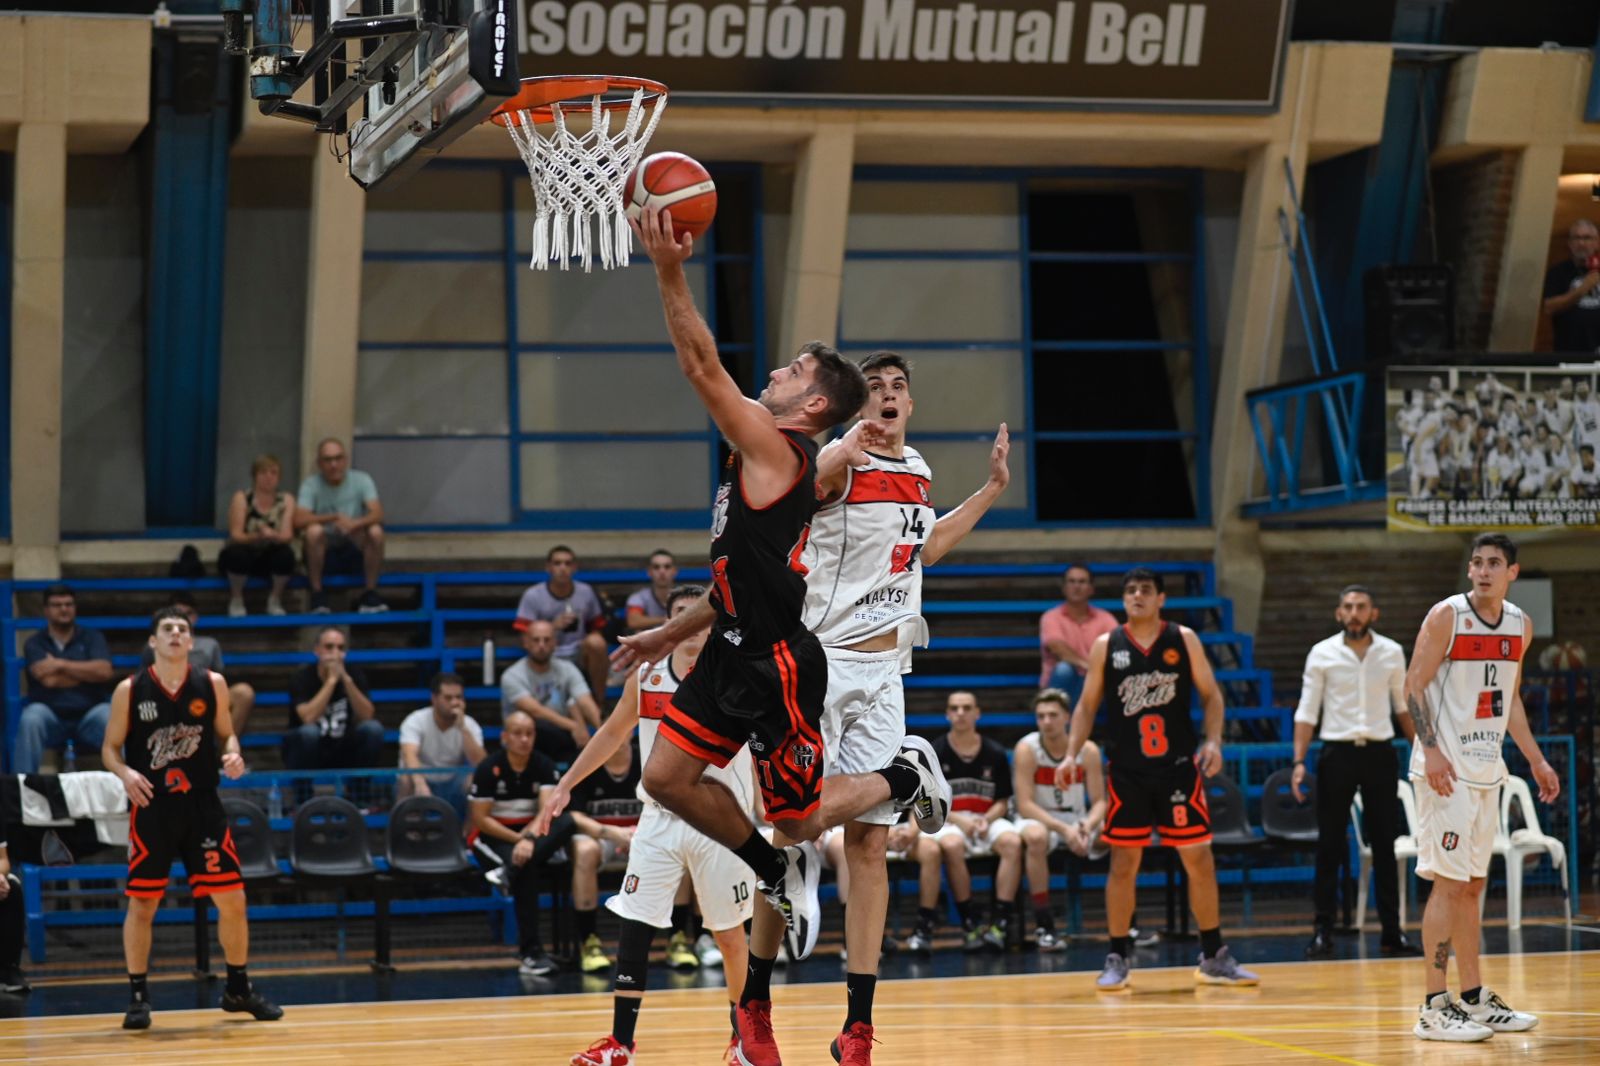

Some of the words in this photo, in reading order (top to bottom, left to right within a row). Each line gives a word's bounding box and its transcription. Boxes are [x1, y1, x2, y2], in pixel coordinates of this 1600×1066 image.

[858, 0, 1075, 63] Mutual
[1085, 2, 1206, 66] Bell
[1396, 500, 1445, 511] PRIMER
[900, 508, 925, 539] 14
[1428, 512, 1445, 525] DE
[1449, 512, 1531, 525] BASQUETBOL
[1484, 663, 1497, 686] 12
[1139, 714, 1168, 756] 8
[1173, 804, 1188, 827] 8
[204, 850, 220, 872] 2
[732, 881, 749, 904] 10
